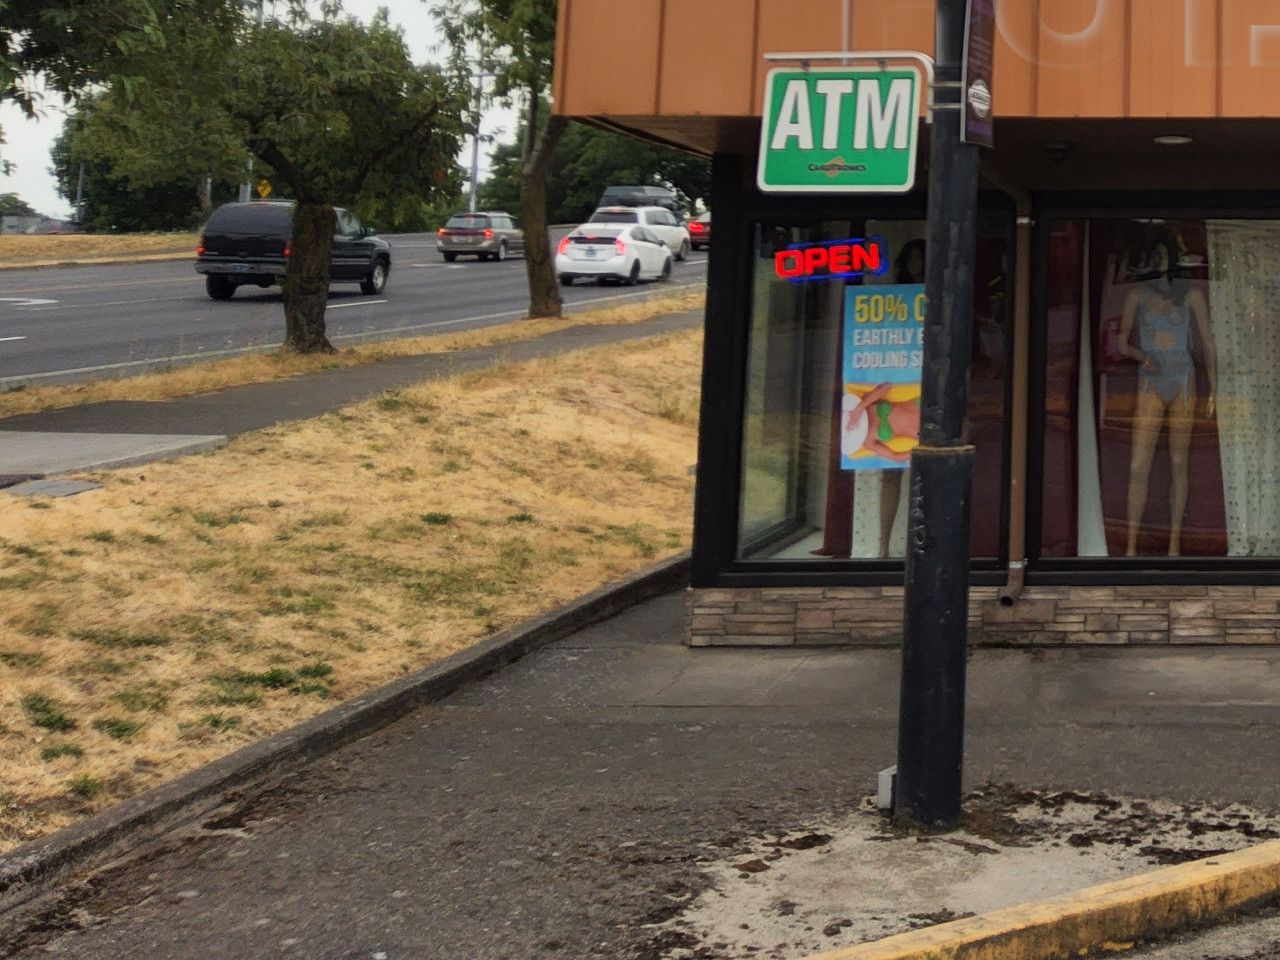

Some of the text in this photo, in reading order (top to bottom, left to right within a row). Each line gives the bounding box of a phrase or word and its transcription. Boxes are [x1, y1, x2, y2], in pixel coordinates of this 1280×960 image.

[770, 78, 912, 150] ATM
[775, 243, 881, 279] OPEN
[854, 293, 908, 323] 50%
[853, 327, 913, 346] EARTHLY
[853, 350, 908, 369] COOLING
